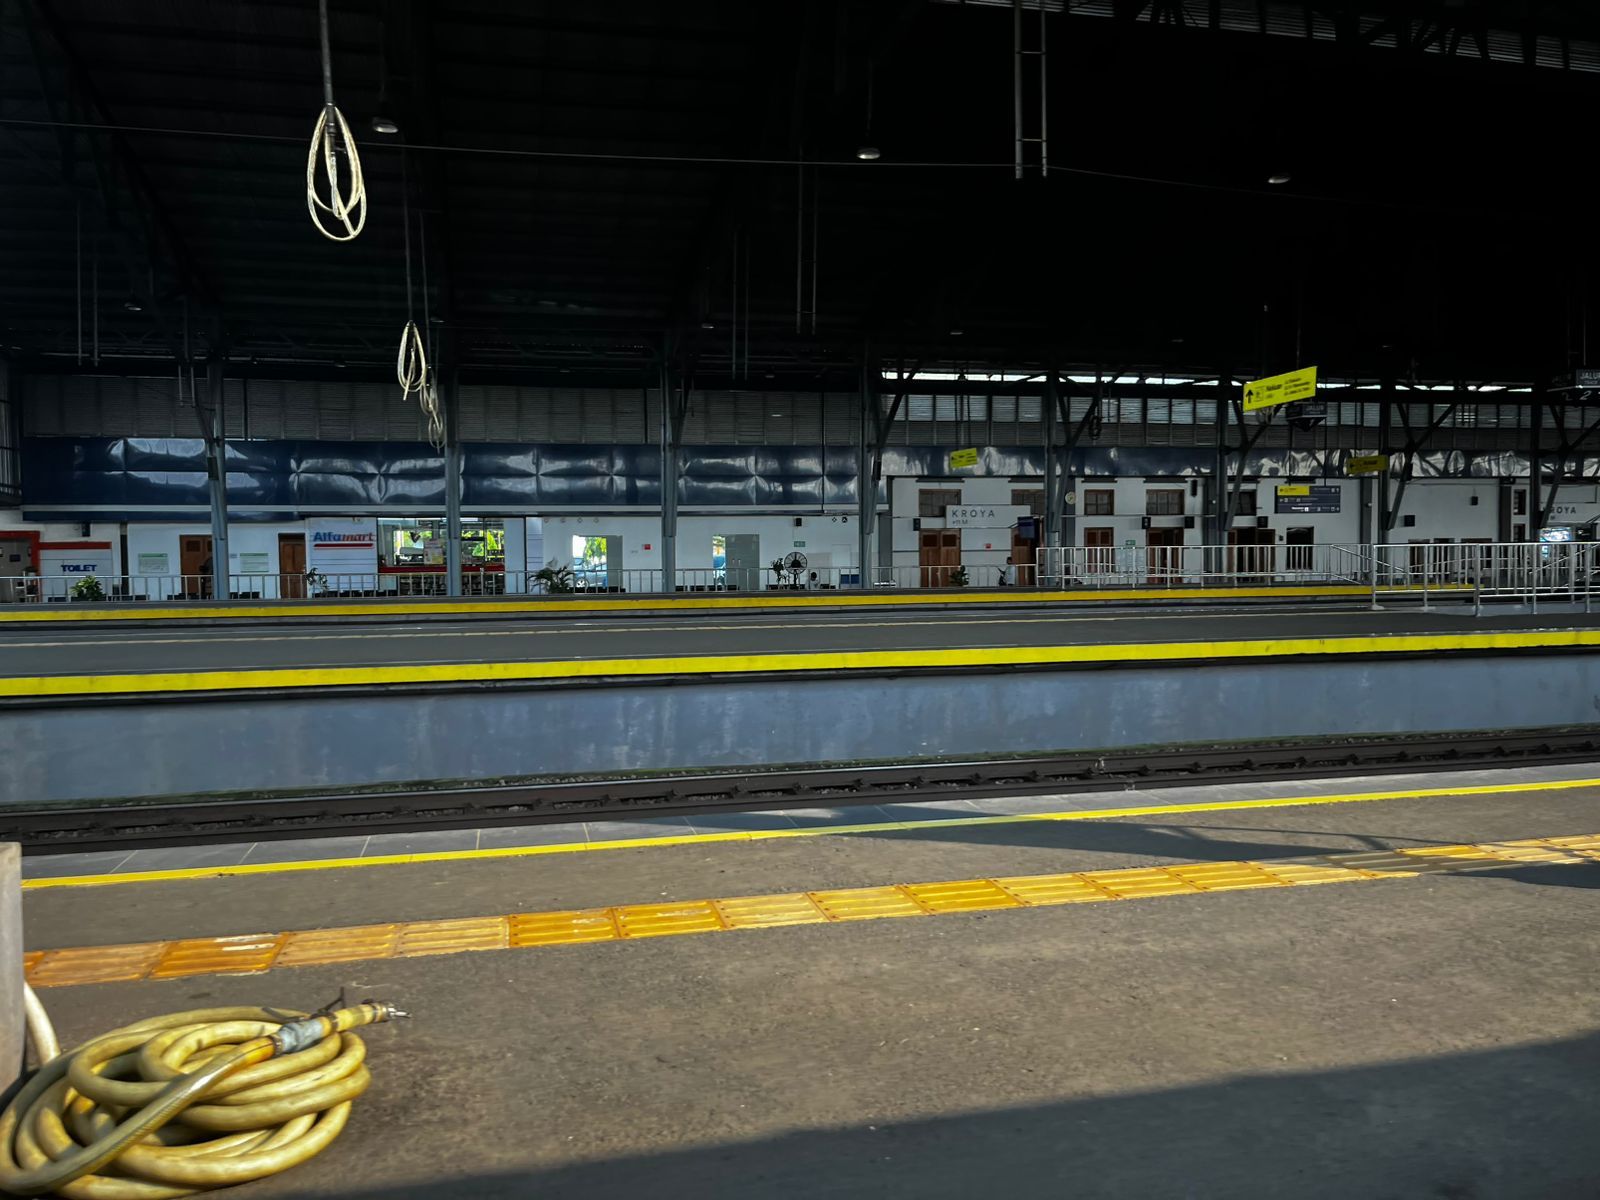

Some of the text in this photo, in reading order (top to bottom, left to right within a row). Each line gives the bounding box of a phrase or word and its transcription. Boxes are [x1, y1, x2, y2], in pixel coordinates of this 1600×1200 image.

[952, 509, 995, 518] KROYA
[313, 531, 374, 542] Alfamart
[61, 564, 97, 572] TOILET
